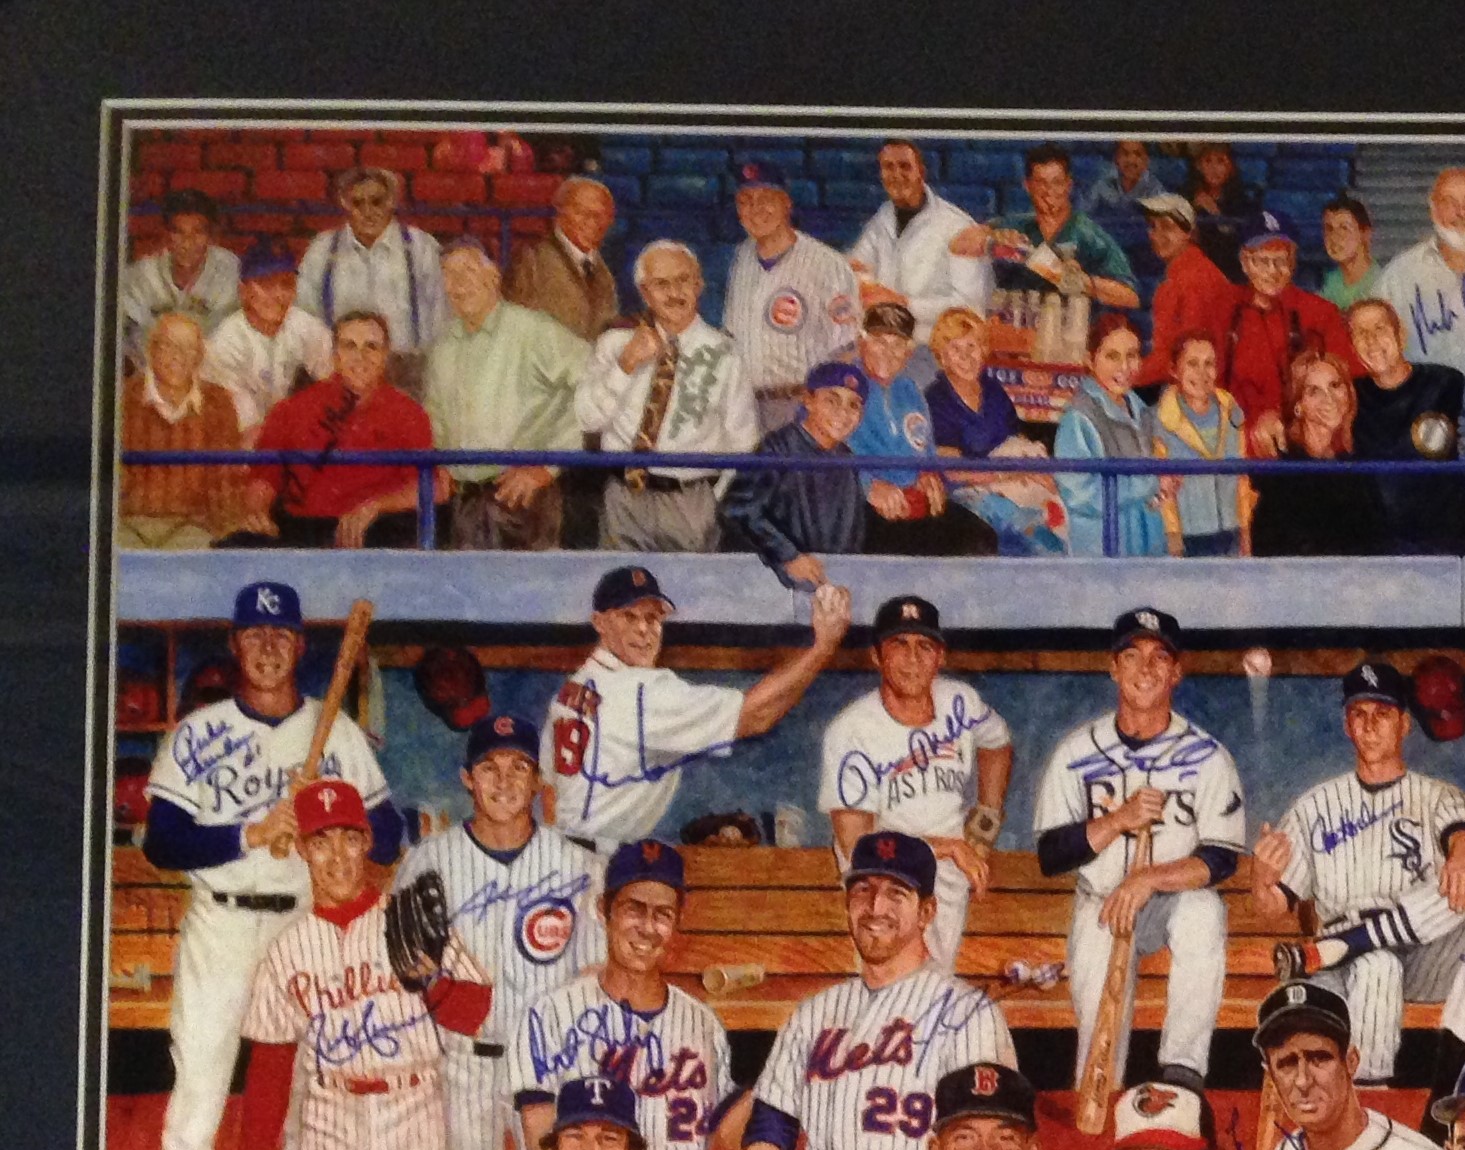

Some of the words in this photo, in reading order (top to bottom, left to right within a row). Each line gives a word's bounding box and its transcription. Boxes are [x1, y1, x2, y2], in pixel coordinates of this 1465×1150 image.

[807, 1017, 916, 1082] Mets
[585, 1077, 611, 1105] T
[972, 1066, 1000, 1096] B
[861, 1087, 934, 1138] 29
